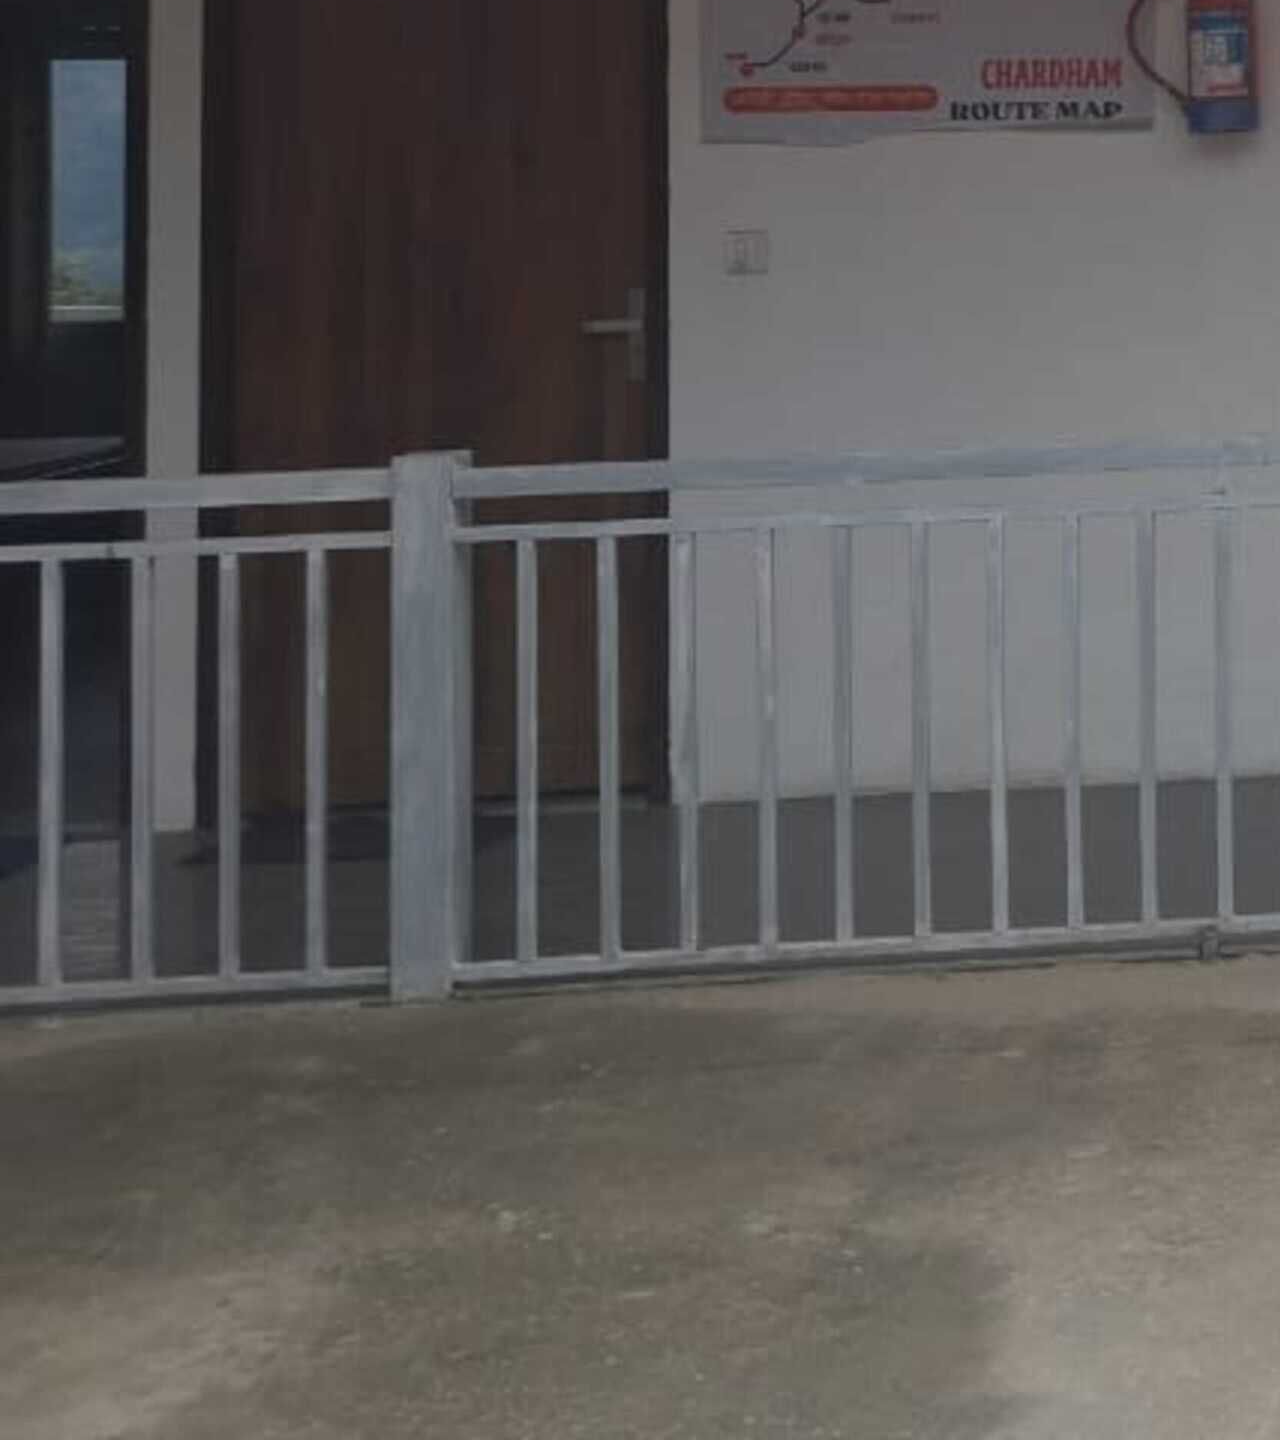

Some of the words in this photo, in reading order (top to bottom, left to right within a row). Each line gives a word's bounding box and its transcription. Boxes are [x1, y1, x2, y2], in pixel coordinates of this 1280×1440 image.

[982, 58, 1123, 90] CHARDHAM
[951, 100, 1051, 122] ROUTE
[1054, 100, 1123, 121] MAP
